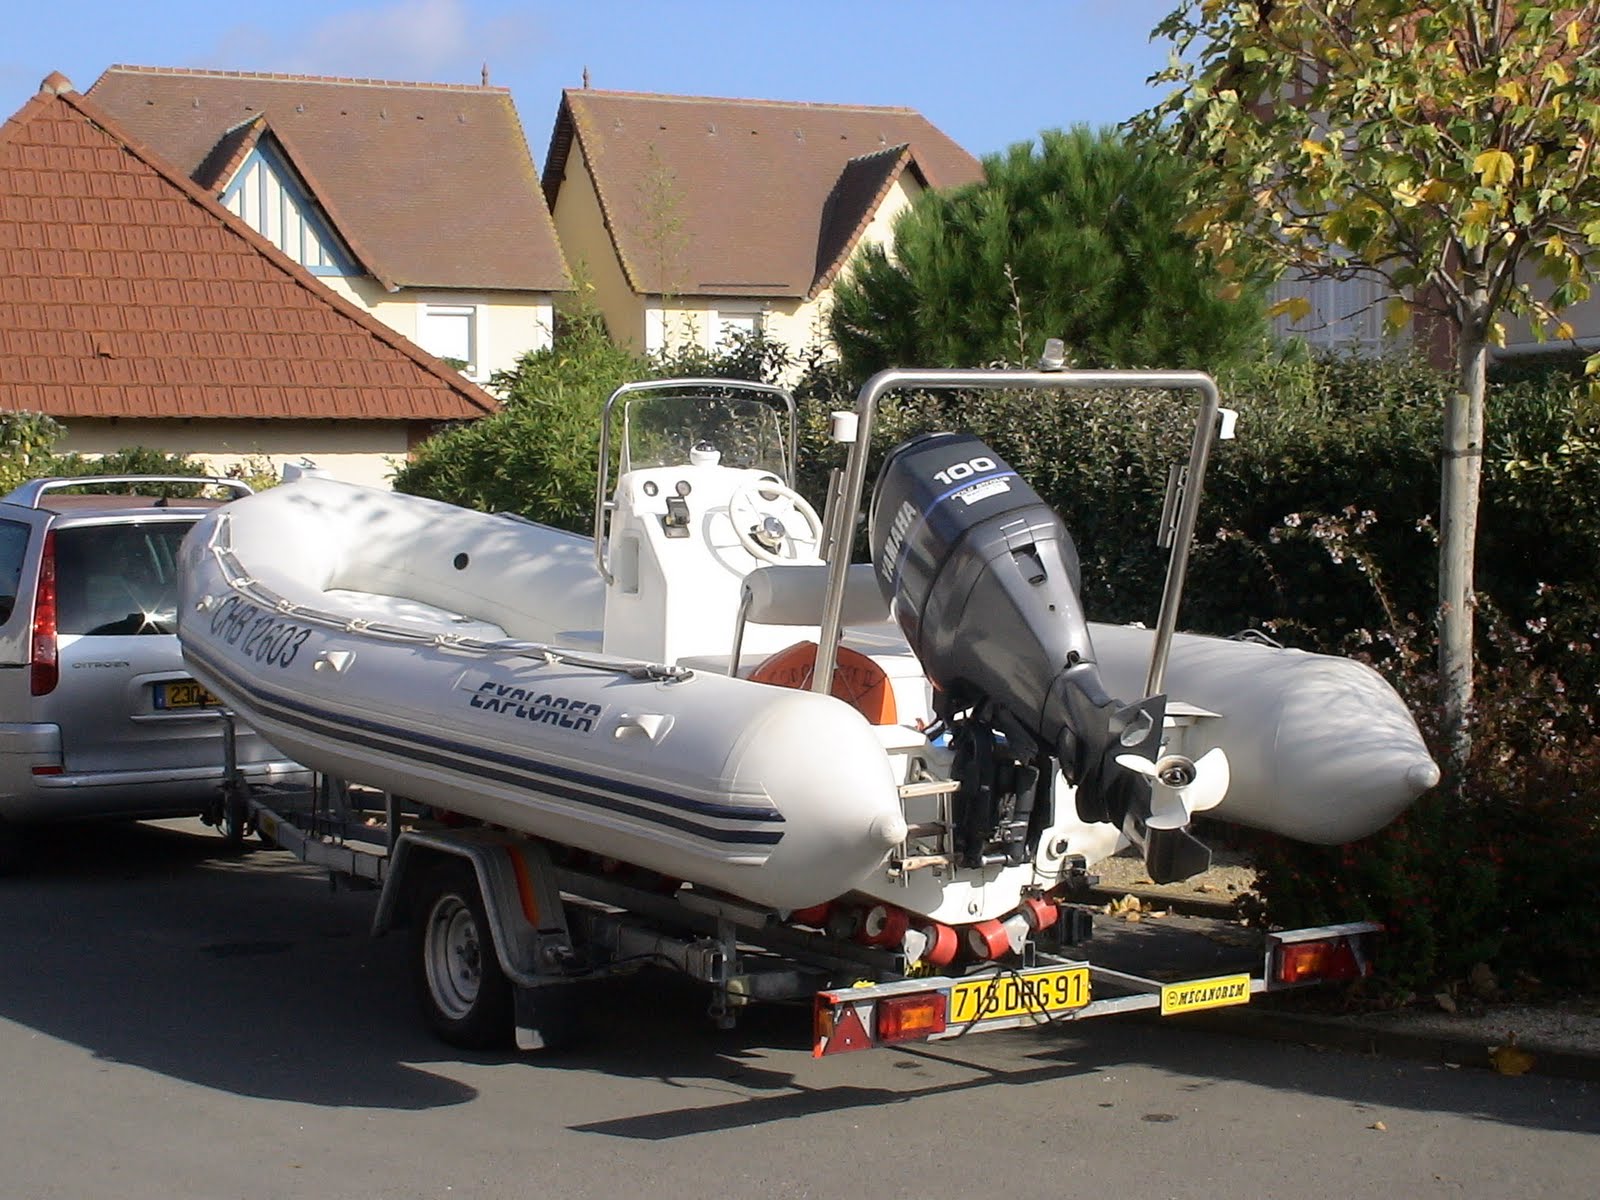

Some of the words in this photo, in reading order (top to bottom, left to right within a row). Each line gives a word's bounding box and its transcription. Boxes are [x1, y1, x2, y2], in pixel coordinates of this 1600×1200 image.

[933, 456, 997, 485] 100
[882, 501, 917, 583] YAMAHA
[470, 681, 602, 733] EXPLORER
[1055, 974, 1081, 1004] 91
